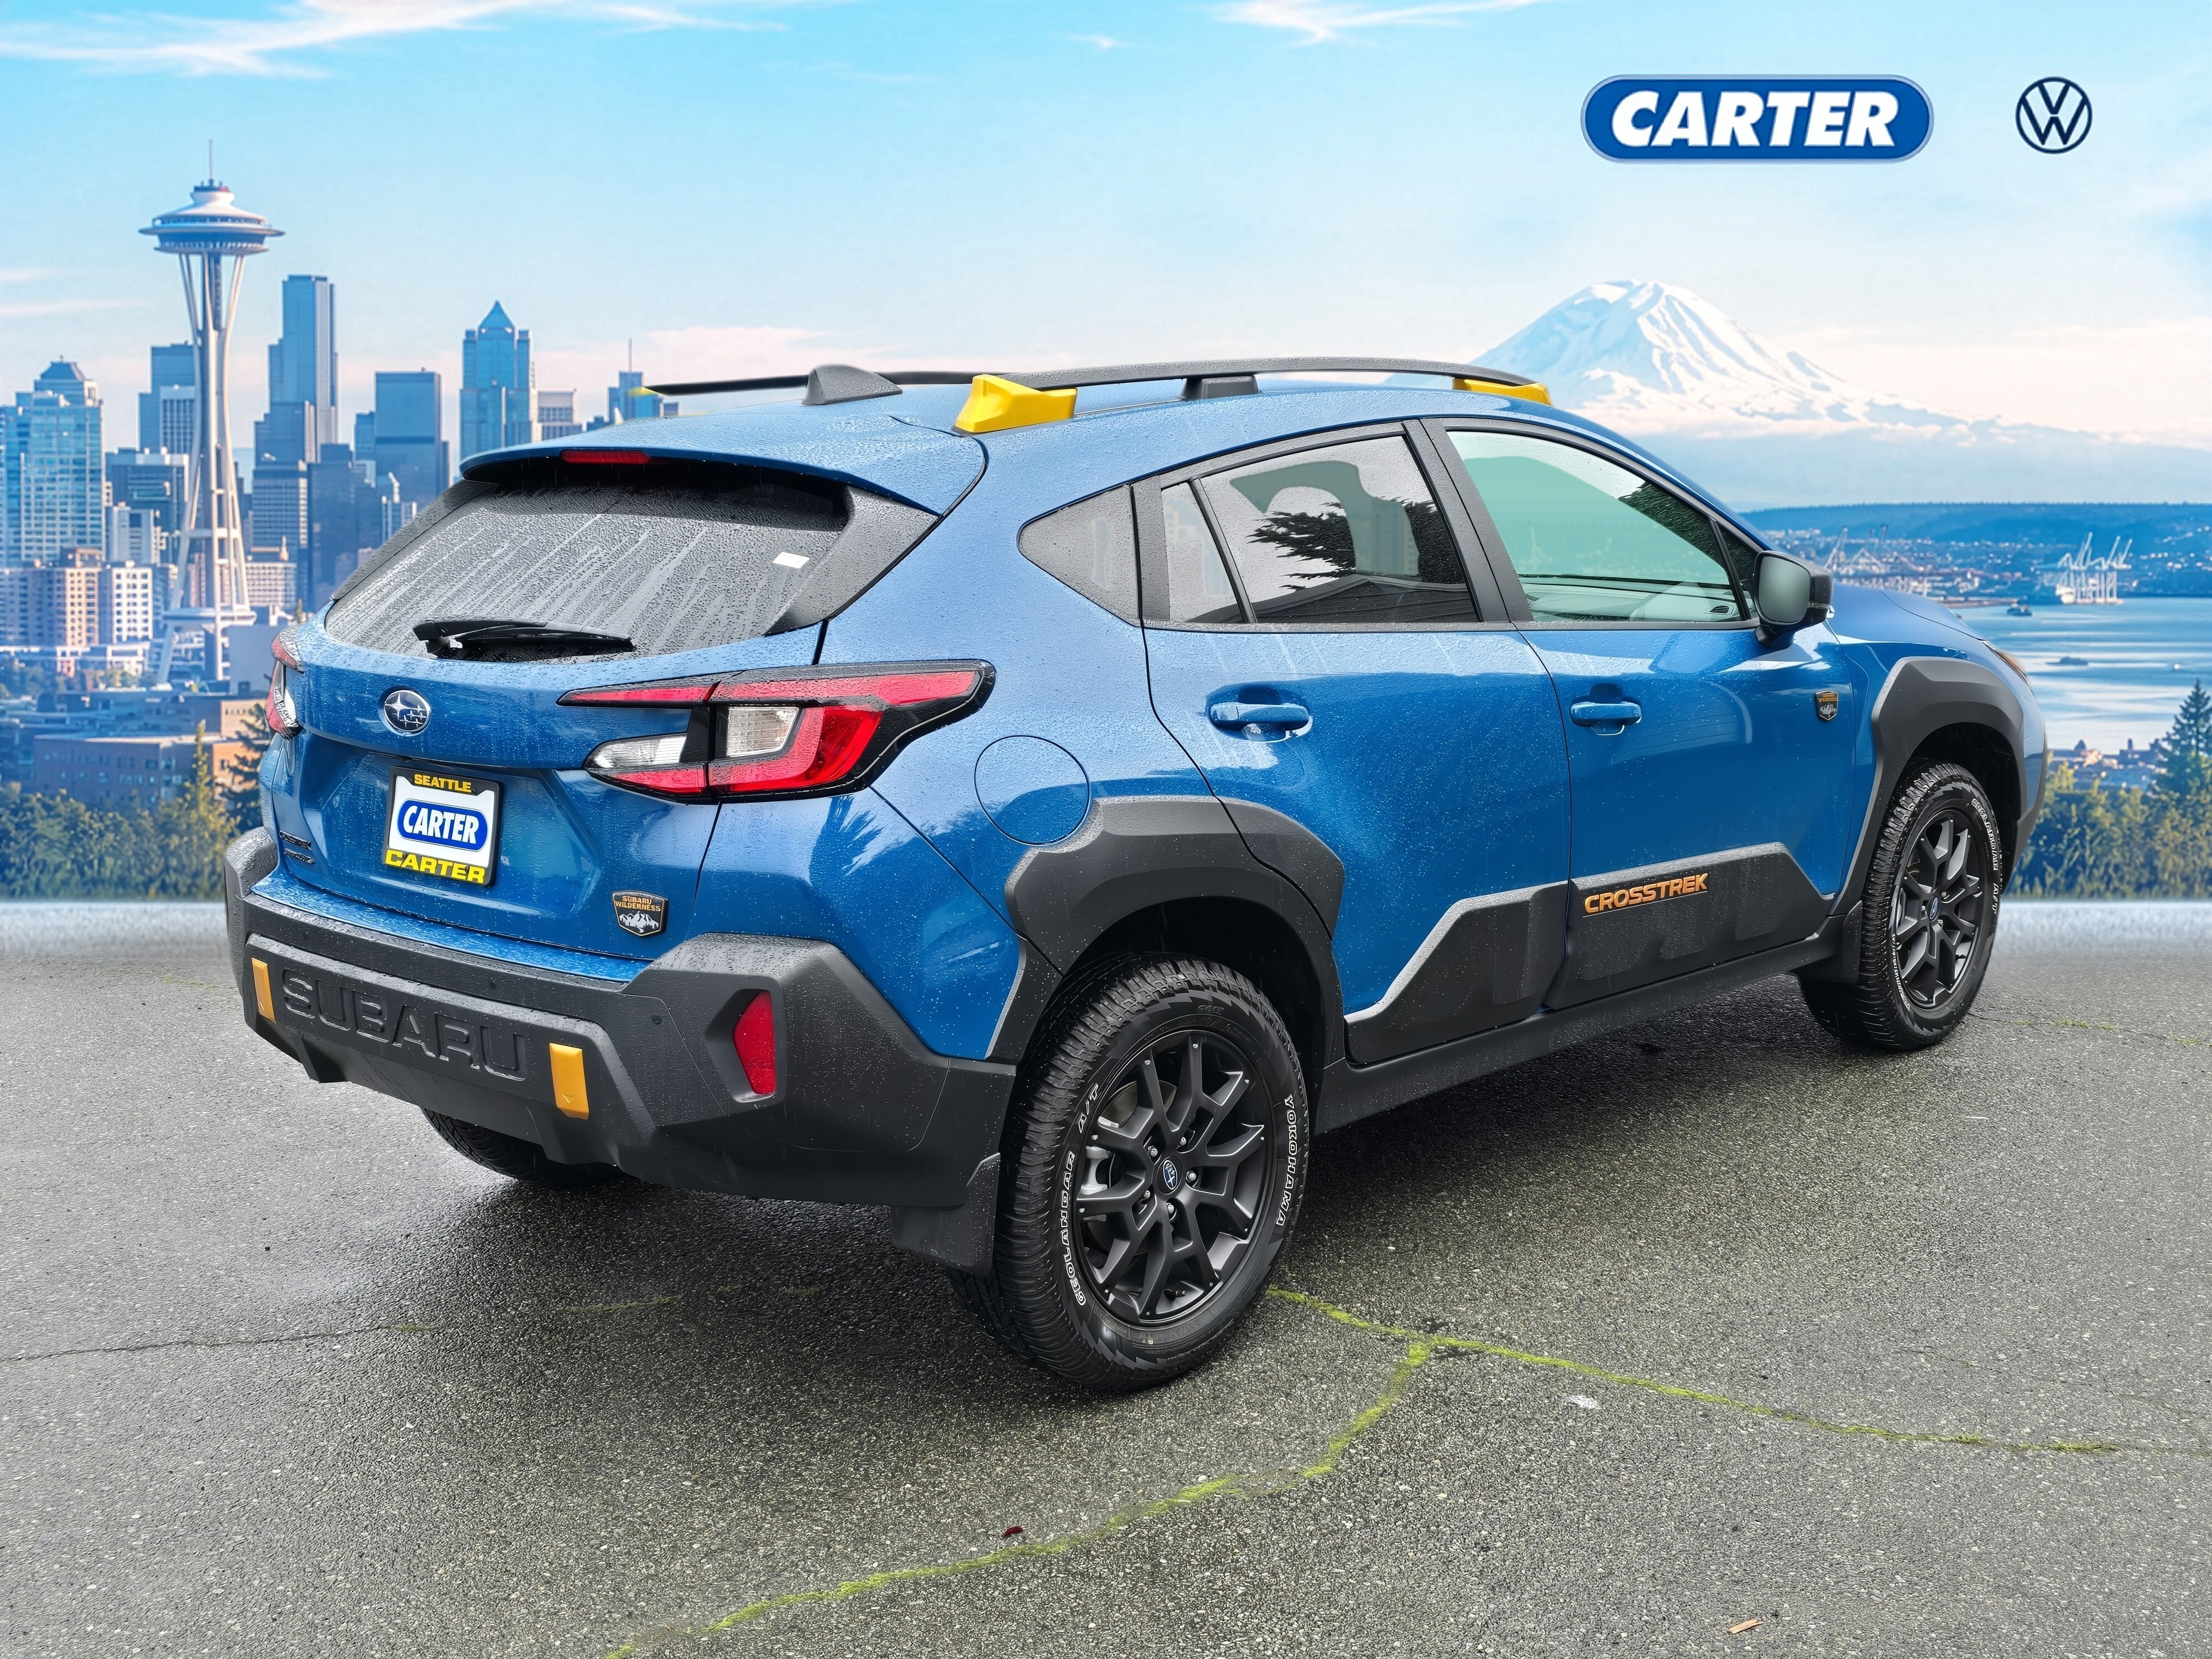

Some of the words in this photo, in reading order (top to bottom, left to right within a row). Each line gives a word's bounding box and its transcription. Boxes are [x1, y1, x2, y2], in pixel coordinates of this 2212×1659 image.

[414, 774, 472, 793] SEATTLE
[403, 805, 479, 844] CARTER
[385, 849, 486, 884] CARTER
[614, 901, 661, 911] WILDERNESS
[622, 895, 652, 905] SUBARU
[1584, 873, 1708, 914] CROSSTREK
[281, 968, 526, 1082] SUBARU
[1276, 1094, 1298, 1226] YOKOHAMA
[1060, 1151, 1086, 1306] GEOLANDAR
